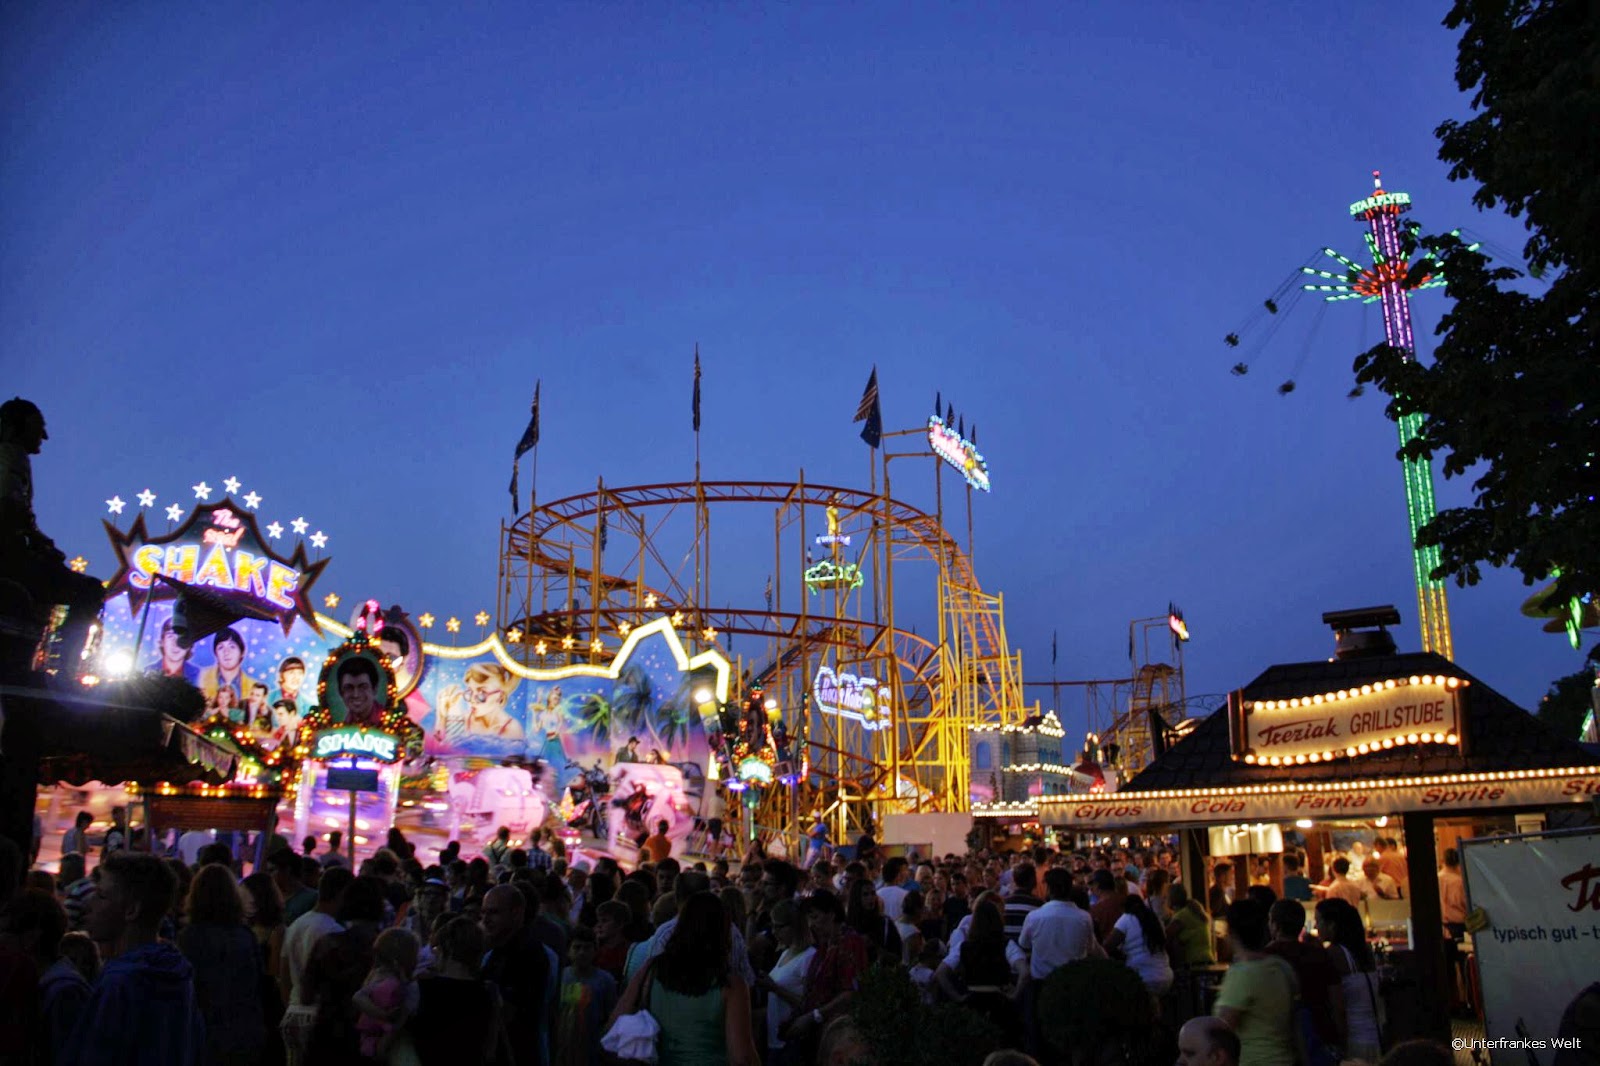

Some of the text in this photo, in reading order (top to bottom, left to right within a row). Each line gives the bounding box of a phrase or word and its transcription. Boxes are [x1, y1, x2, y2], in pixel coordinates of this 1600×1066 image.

[129, 544, 298, 609] SHAKE
[1350, 700, 1445, 735] GRILLSTUBE
[317, 731, 395, 760] SHAKE
[1074, 803, 1144, 821] Gyros
[1190, 799, 1246, 815] Cola
[1295, 792, 1369, 810] Fanta
[1421, 785, 1505, 806] Sprite
[1493, 926, 1547, 943] typisch
[1552, 926, 1578, 943] gut
